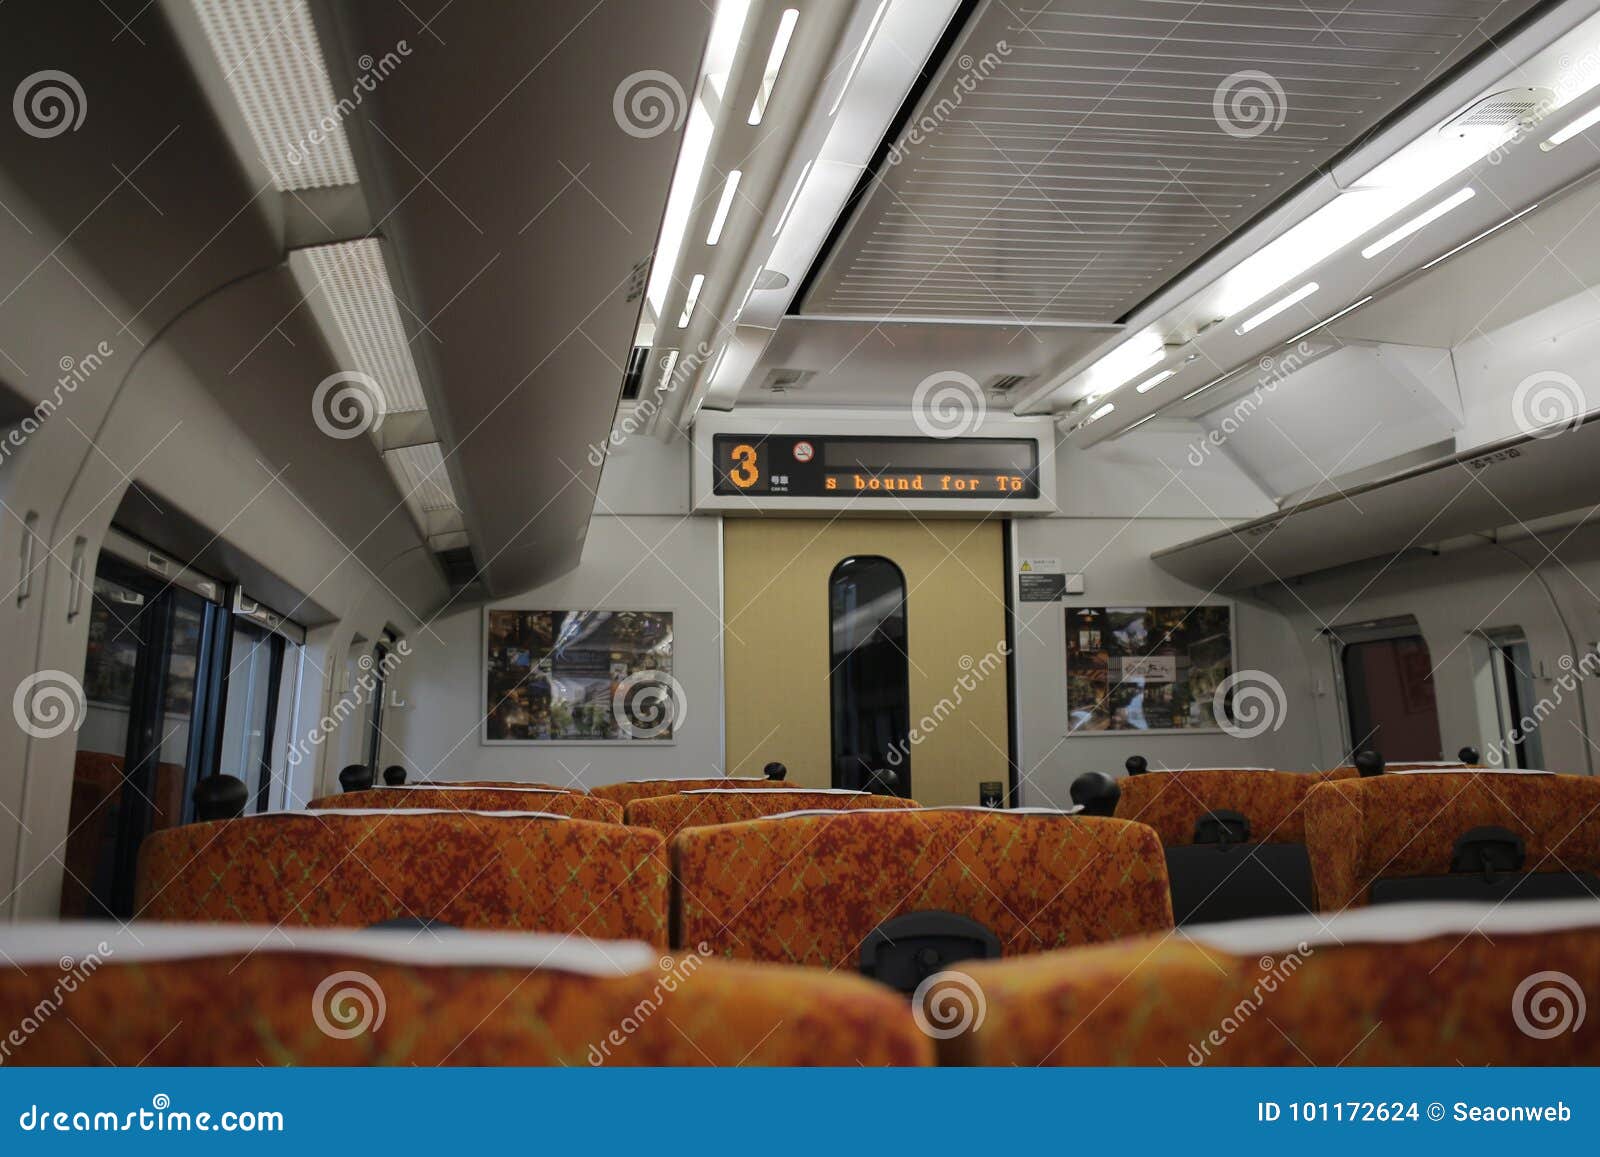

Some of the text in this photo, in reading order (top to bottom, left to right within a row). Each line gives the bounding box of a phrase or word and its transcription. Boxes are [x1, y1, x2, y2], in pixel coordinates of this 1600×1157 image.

[731, 444, 759, 487] 3
[854, 475, 923, 490] bound
[941, 476, 980, 490] for
